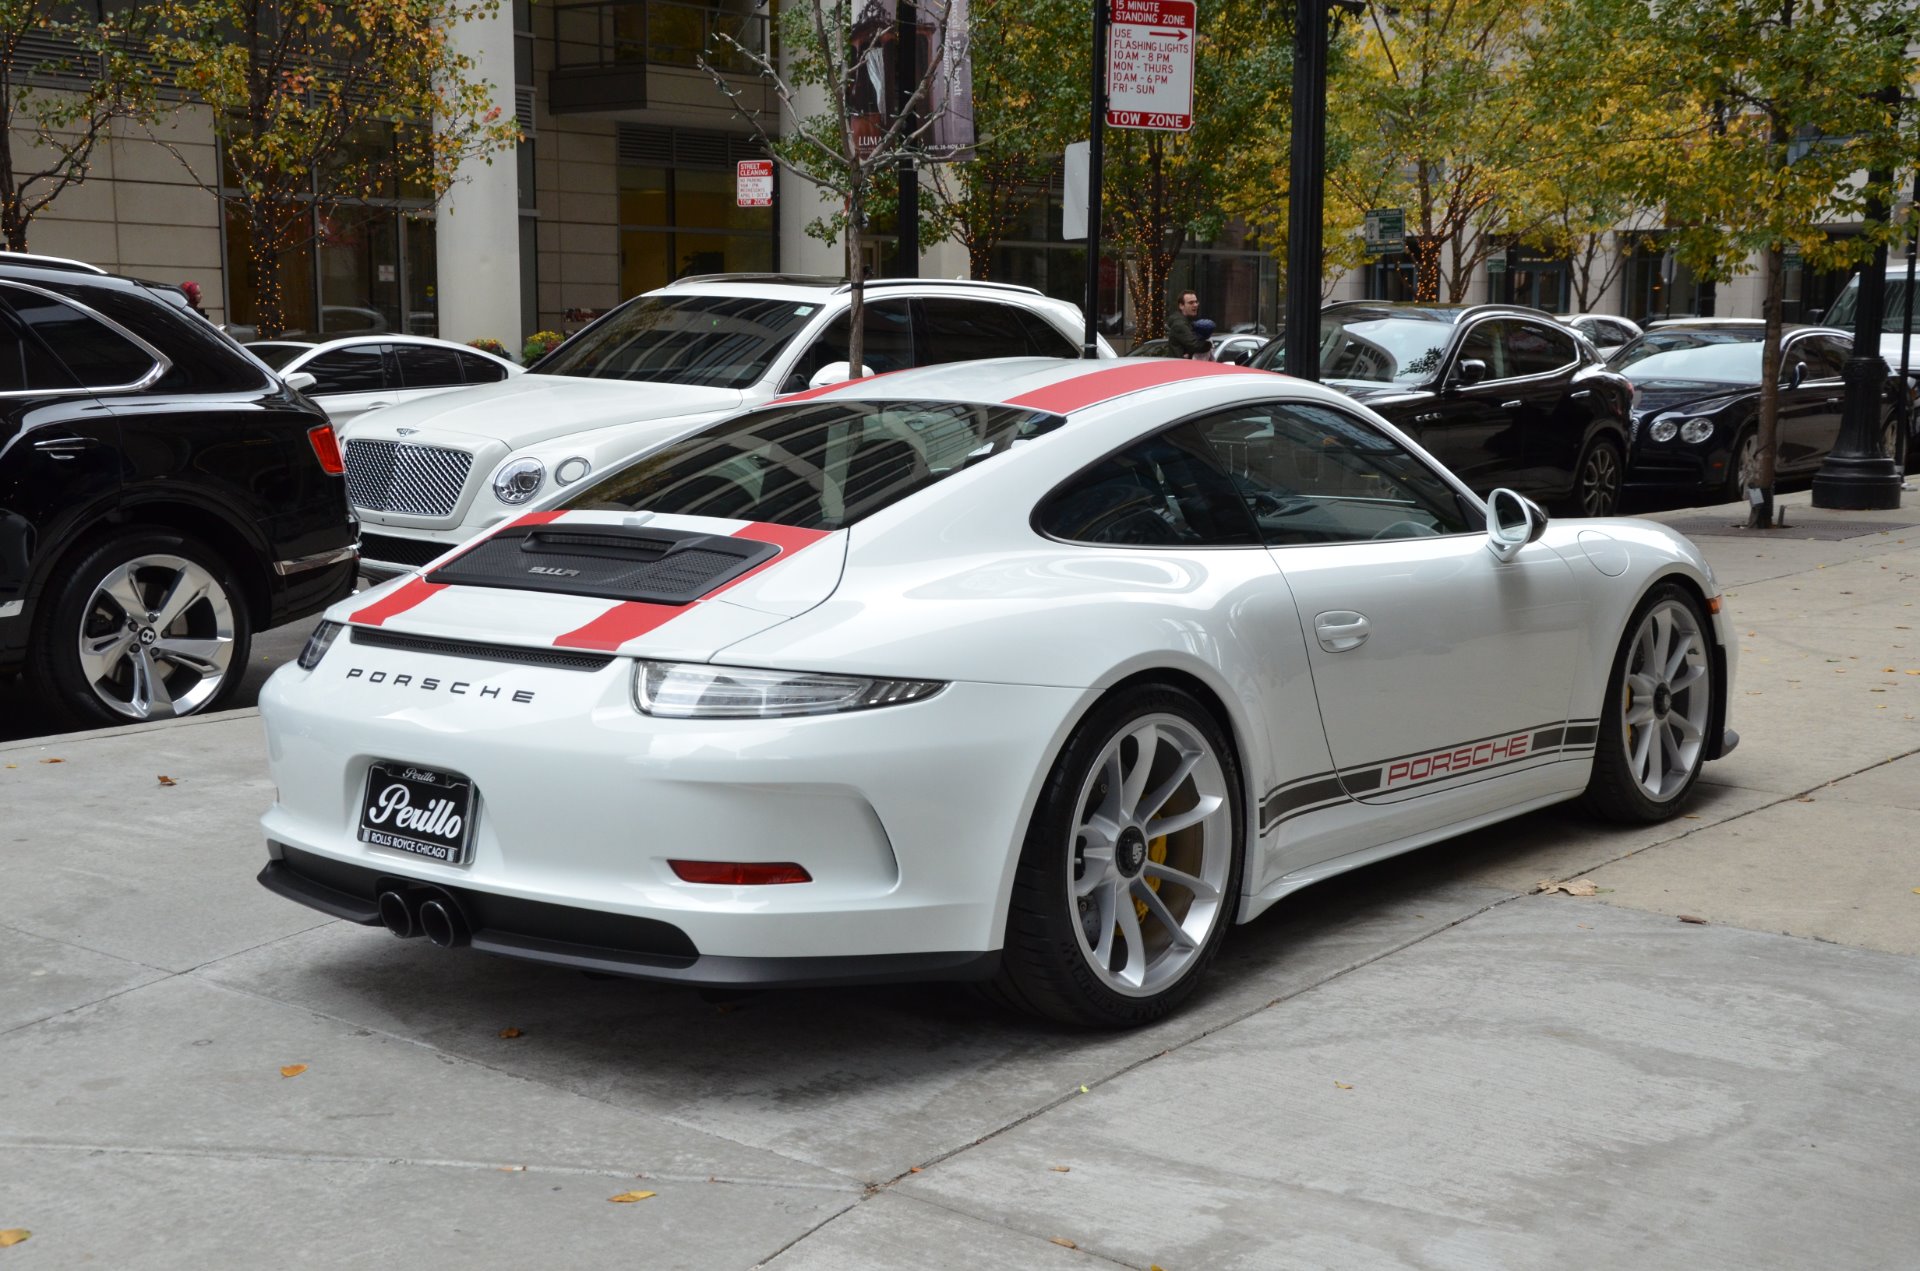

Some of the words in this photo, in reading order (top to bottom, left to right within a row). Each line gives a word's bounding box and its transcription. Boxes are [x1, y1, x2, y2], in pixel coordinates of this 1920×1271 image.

[1115, 0, 1125, 10] 15
[1127, 1, 1160, 12] MINUTE
[1115, 11, 1158, 23] STANDING
[1162, 14, 1186, 25] ZONE
[1114, 29, 1132, 39] USE
[1114, 40, 1157, 52] FLASHING
[1159, 43, 1189, 54] LIGHTS
[1114, 50, 1124, 60] 10
[1126, 51, 1139, 61] AM
[1147, 53, 1154, 62] 8
[1156, 53, 1170, 63] PM
[1113, 61, 1133, 71] MON
[1143, 63, 1174, 74] THURS
[1113, 72, 1122, 81] 10
[1123, 73, 1137, 82] AM
[1147, 75, 1153, 84] 6
[1155, 75, 1168, 85] PM
[1113, 83, 1128, 93] FRI
[1136, 84, 1155, 95] SUN
[1112, 112, 1141, 125] TOW
[1147, 113, 1183, 128] ZONE
[345, 667, 536, 704] PORSCHE
[1387, 734, 1529, 786] PORSCHE
[402, 767, 436, 783] Perillo
[368, 783, 462, 839] Perillo
[370, 832, 392, 846] ROLLS
[392, 837, 415, 851] ROYCE
[416, 843, 446, 859] CHICAGO
